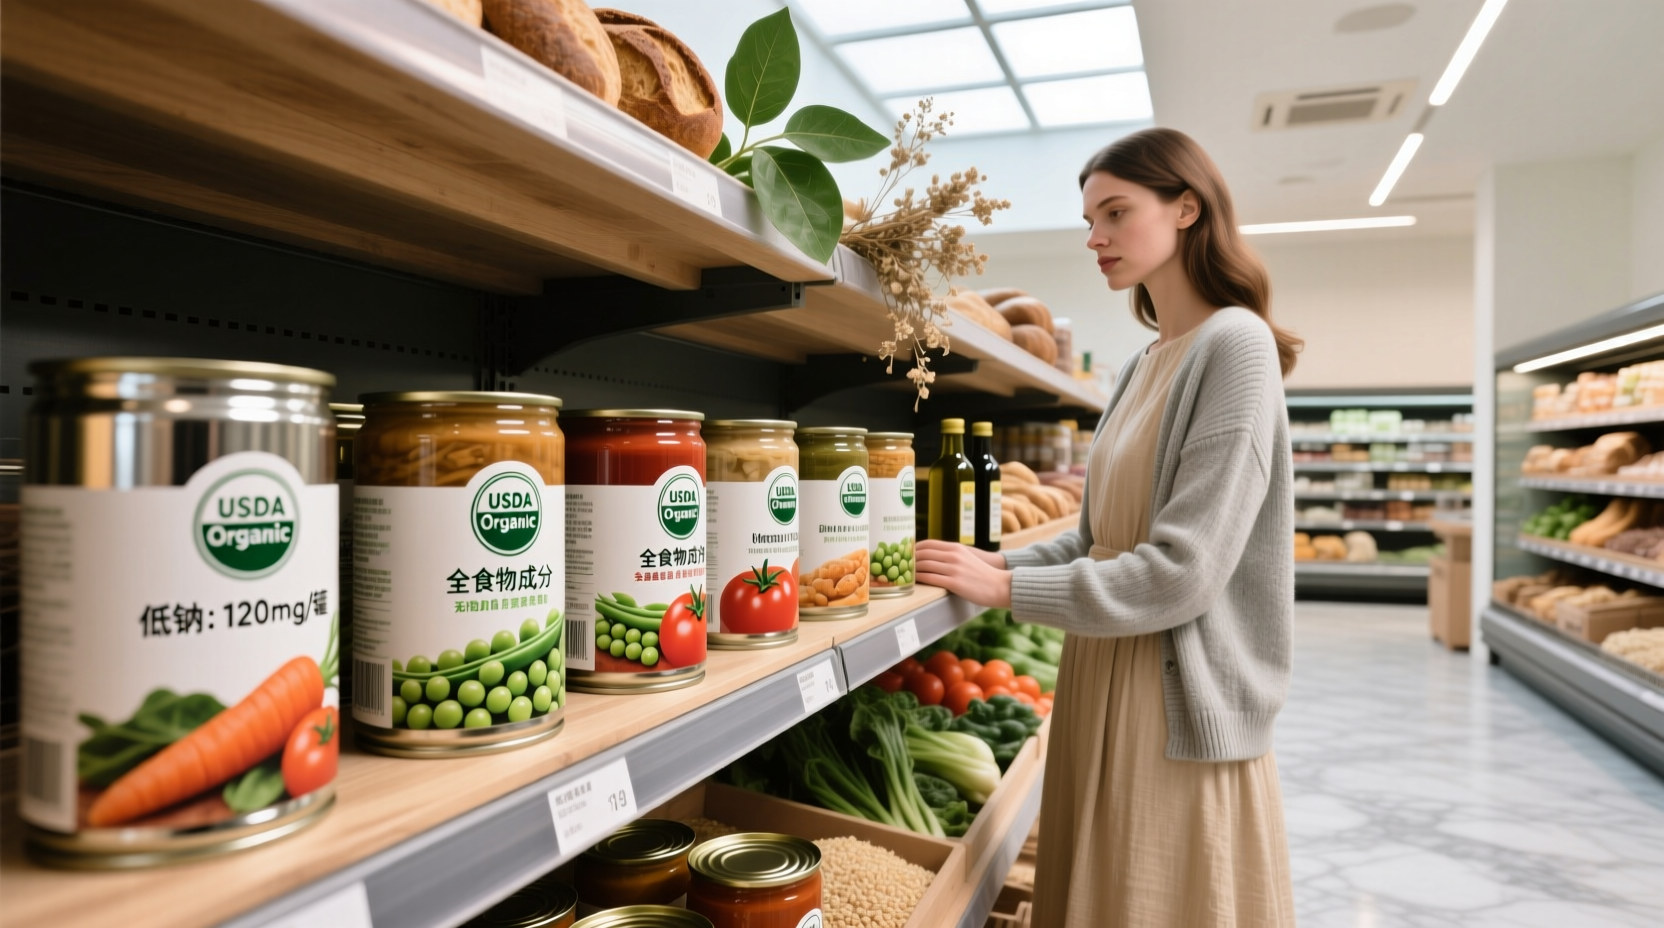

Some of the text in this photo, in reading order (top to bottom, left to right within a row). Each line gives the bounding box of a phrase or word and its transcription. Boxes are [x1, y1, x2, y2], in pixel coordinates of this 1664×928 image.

[218, 496, 285, 518] USDA
[489, 492, 532, 509] USDA
[480, 513, 537, 533] Organic
[206, 522, 291, 550] Organic
[446, 564, 553, 595] 全食物成分
